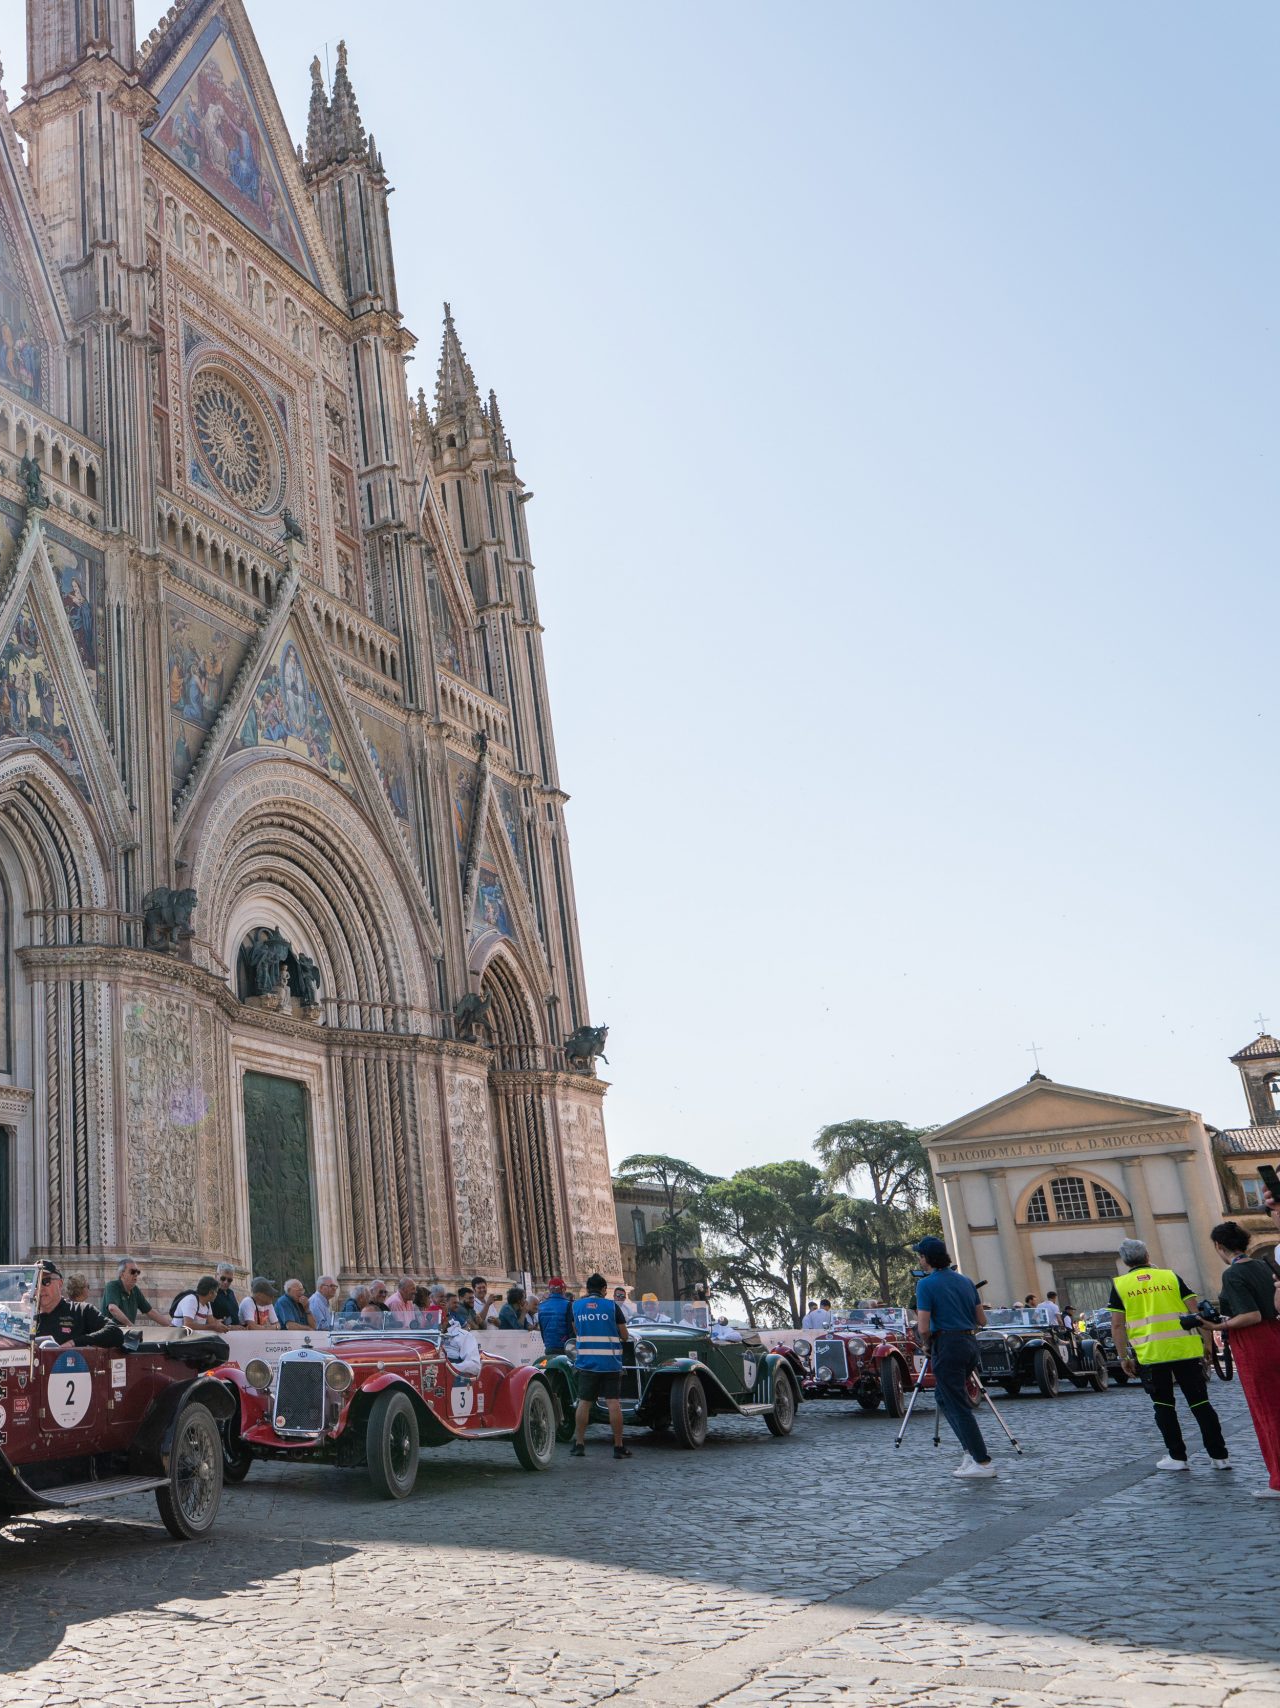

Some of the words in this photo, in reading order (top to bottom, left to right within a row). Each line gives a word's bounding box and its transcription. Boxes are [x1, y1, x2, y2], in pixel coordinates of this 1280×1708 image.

[951, 1148, 996, 1162] JACOBO
[1049, 1141, 1072, 1153] DIC.
[1088, 1138, 1100, 1149] D.
[1127, 1284, 1173, 1298] MARSHAL
[577, 1313, 609, 1322] PHOTO
[65, 1380, 75, 1406] 2
[460, 1391, 466, 1408] 3
